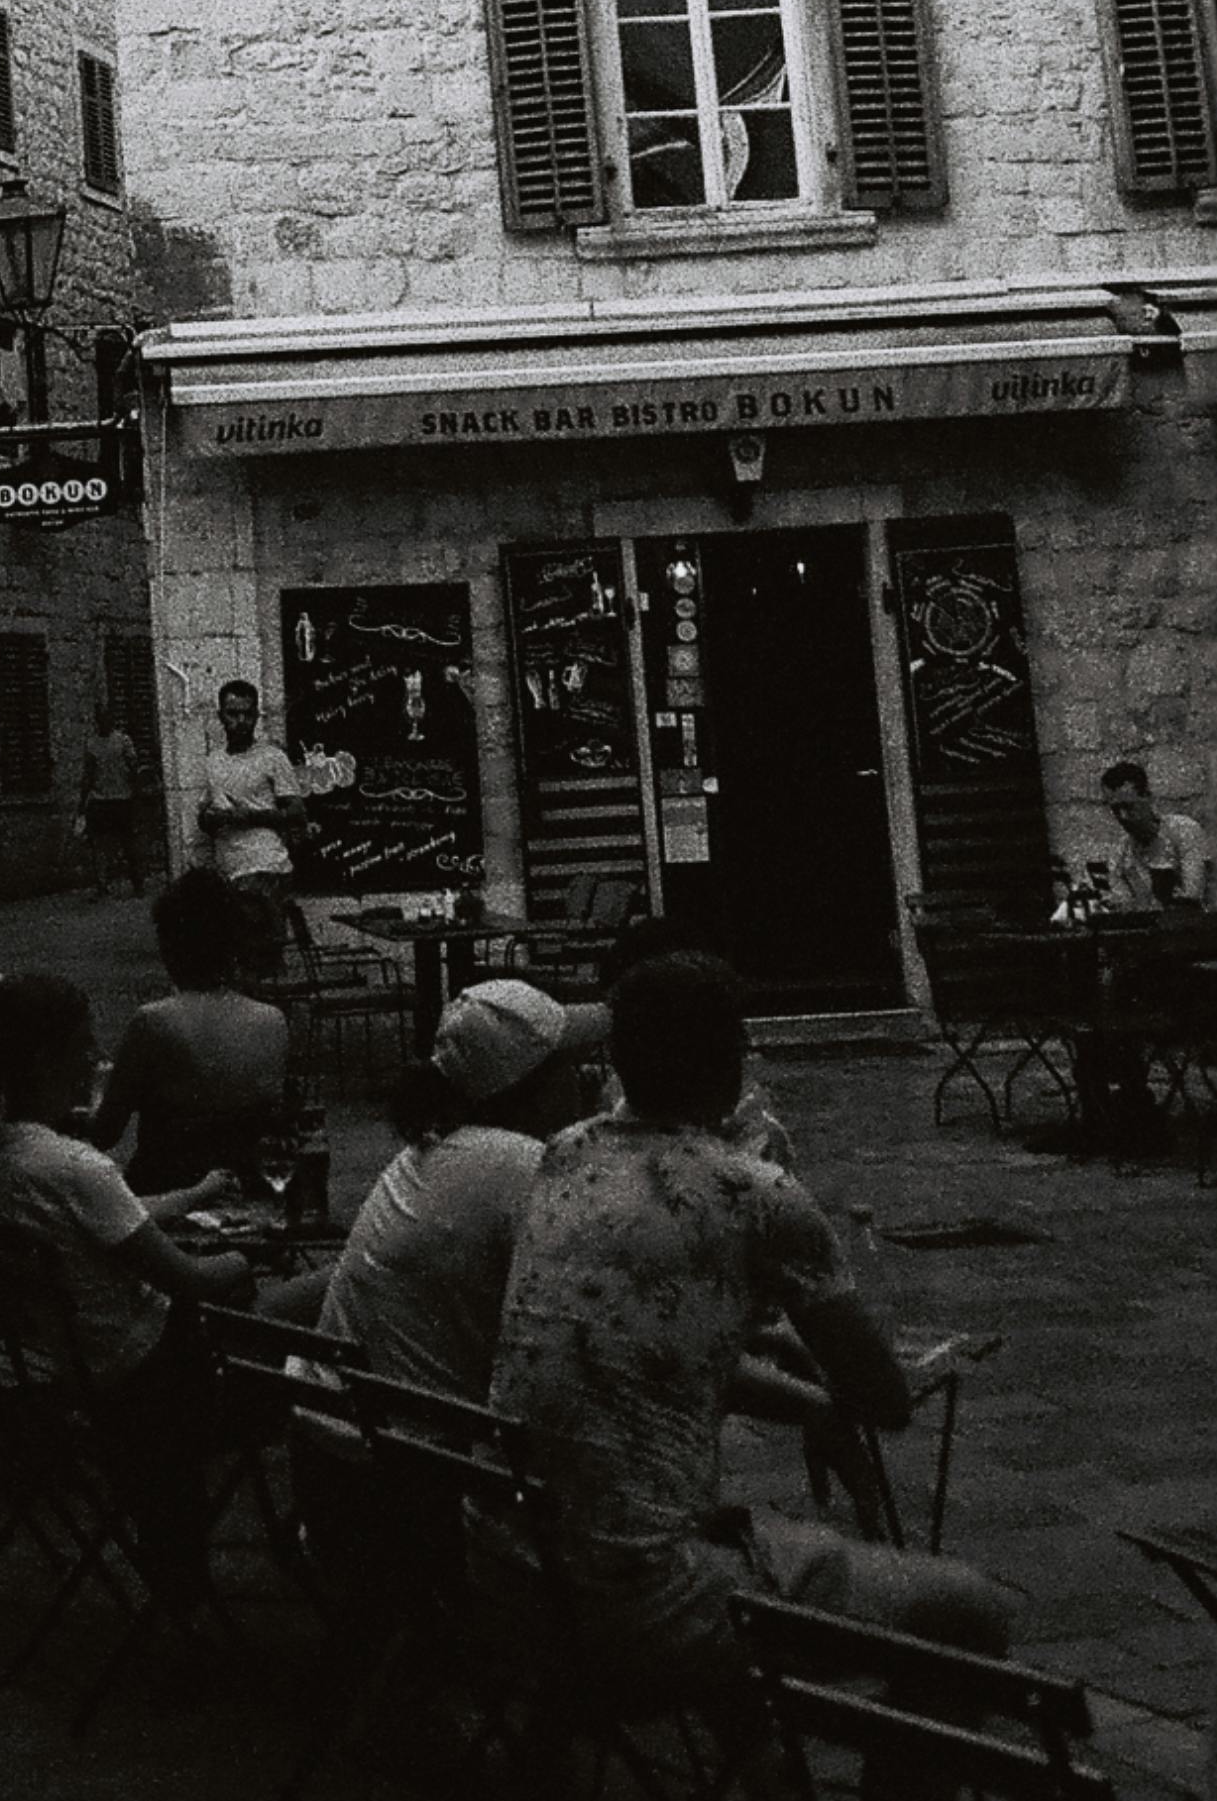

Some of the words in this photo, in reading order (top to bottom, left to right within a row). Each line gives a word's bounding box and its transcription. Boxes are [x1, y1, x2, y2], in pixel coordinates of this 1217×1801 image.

[421, 409, 521, 436] SNACK
[534, 405, 595, 432] BAR
[611, 401, 718, 427] BISTRO
[737, 386, 895, 419] BOKUN
